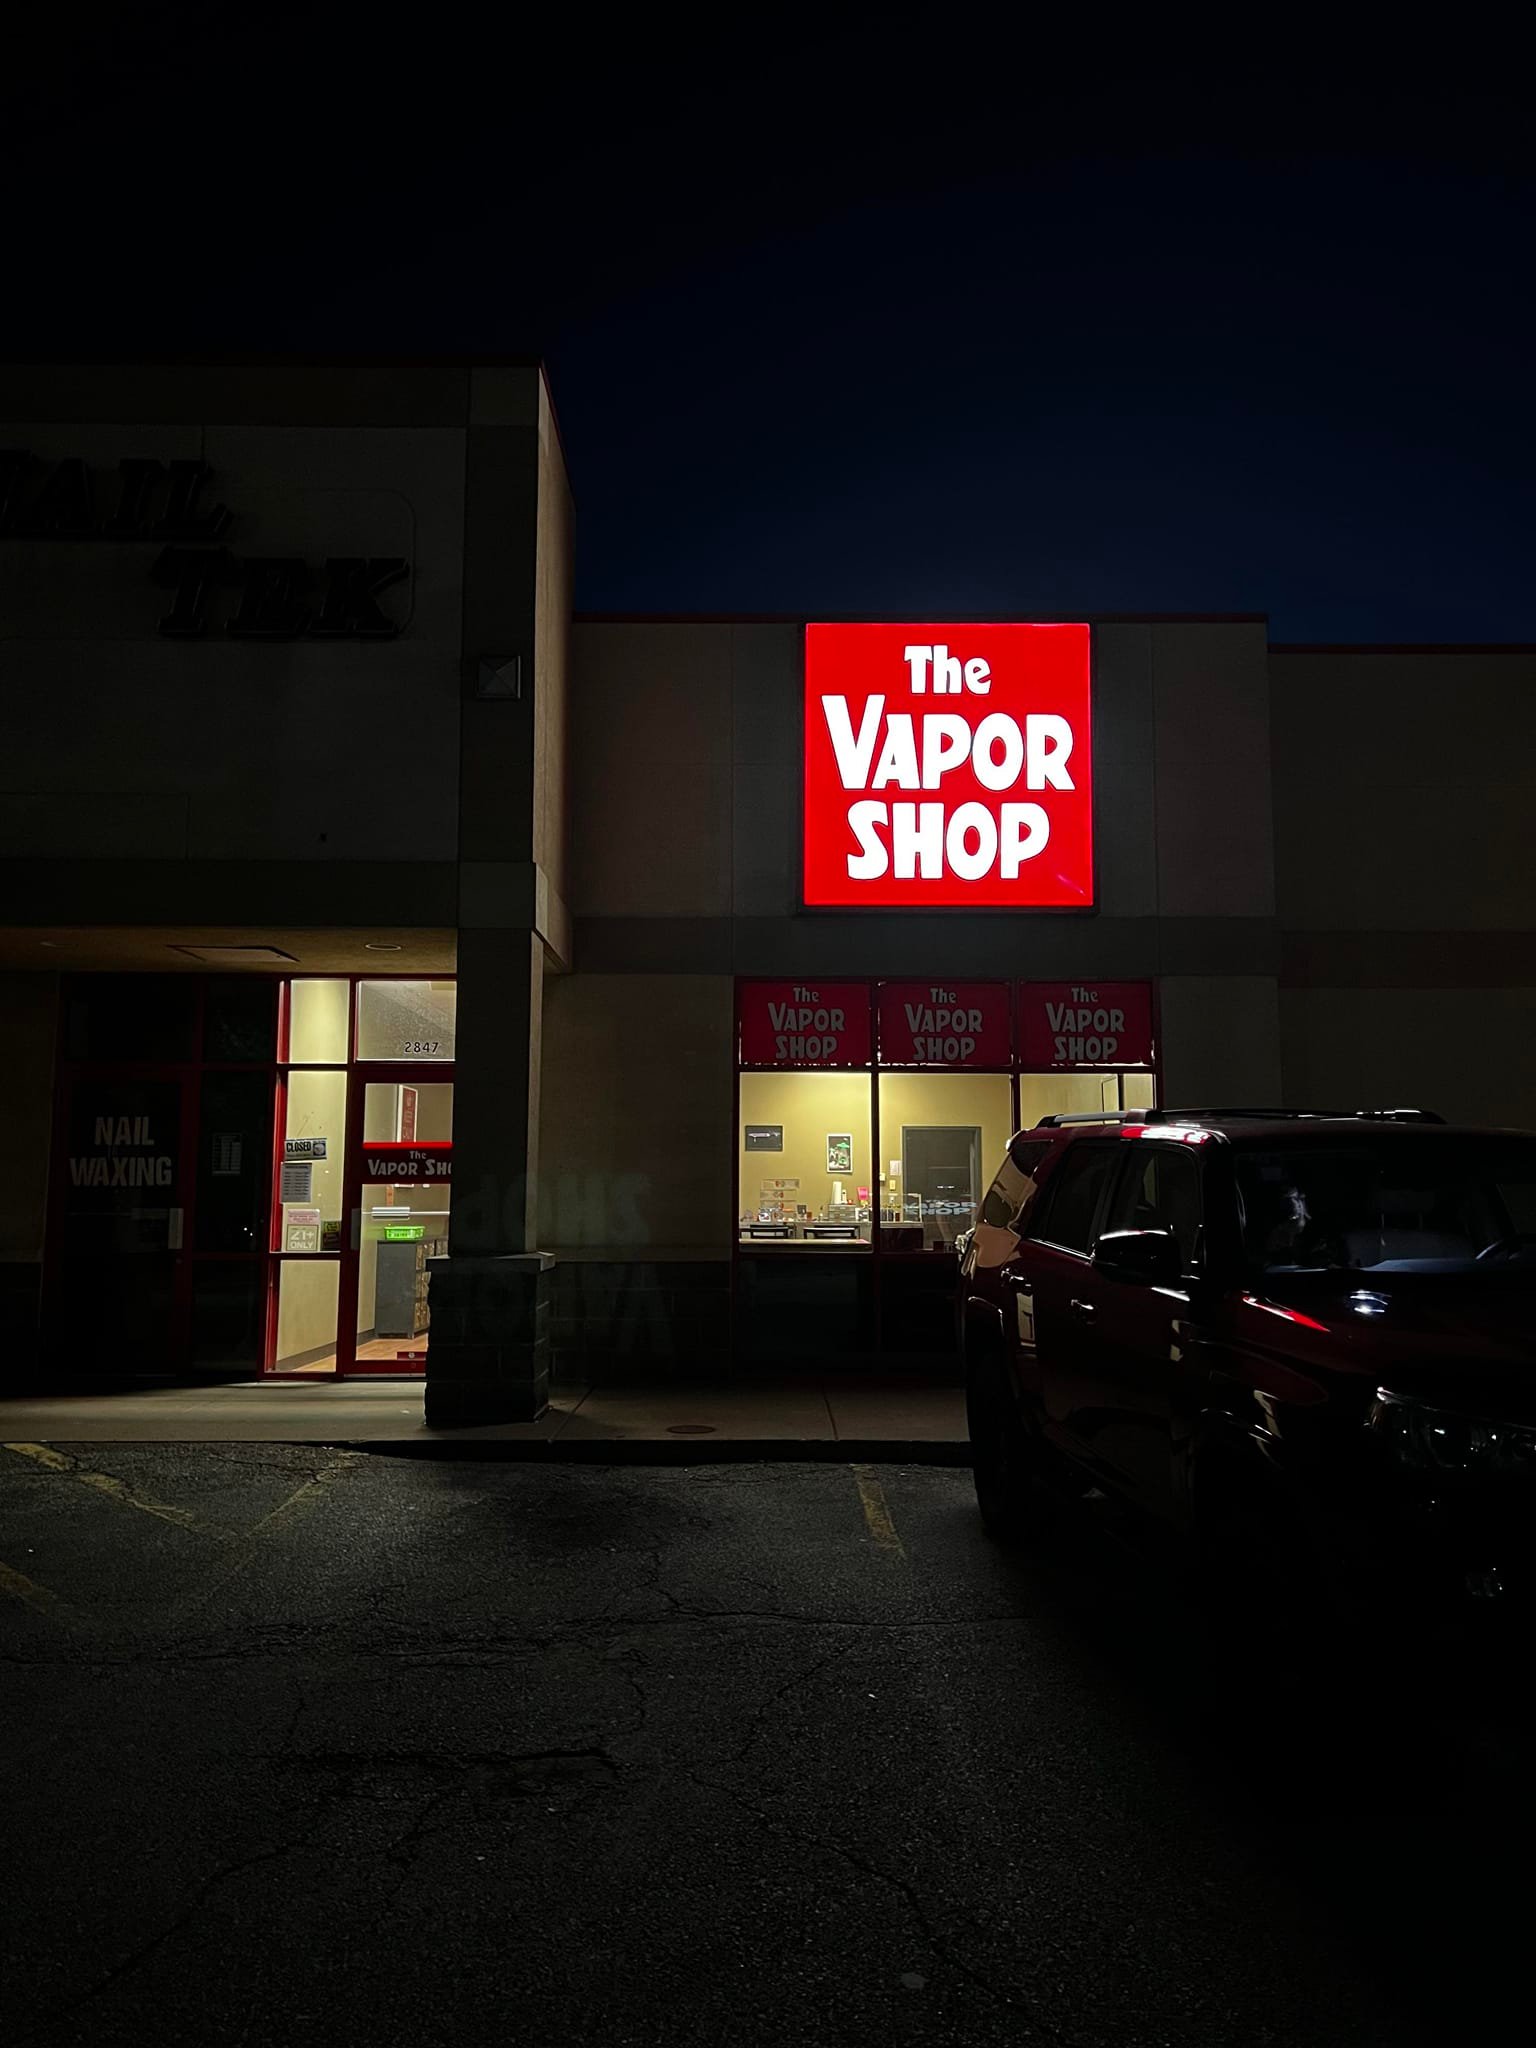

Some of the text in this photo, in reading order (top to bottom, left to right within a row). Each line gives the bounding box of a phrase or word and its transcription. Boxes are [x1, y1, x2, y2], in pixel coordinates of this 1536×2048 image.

[151, 545, 410, 638] TEK
[904, 645, 991, 694] The
[821, 694, 1075, 791] VAPOR
[847, 800, 1050, 881] SHOP
[793, 987, 819, 1003] The
[930, 988, 957, 1004] The
[1071, 987, 1099, 1003] The
[767, 1002, 845, 1032] VAPOR
[904, 1003, 983, 1033] VAPOR
[1045, 1003, 1125, 1034] VAPOR
[404, 1041, 439, 1053] 2847
[775, 1036, 837, 1060] SHOP
[913, 1037, 976, 1061] SHOP
[1055, 1036, 1119, 1061] SHOP
[94, 1116, 155, 1146] NAIL
[286, 1141, 312, 1153] CLOSED
[408, 1150, 427, 1160] The
[69, 1156, 173, 1186] WAXING
[367, 1158, 419, 1176] VAPOR
[290, 1241, 314, 1249] ONLY
